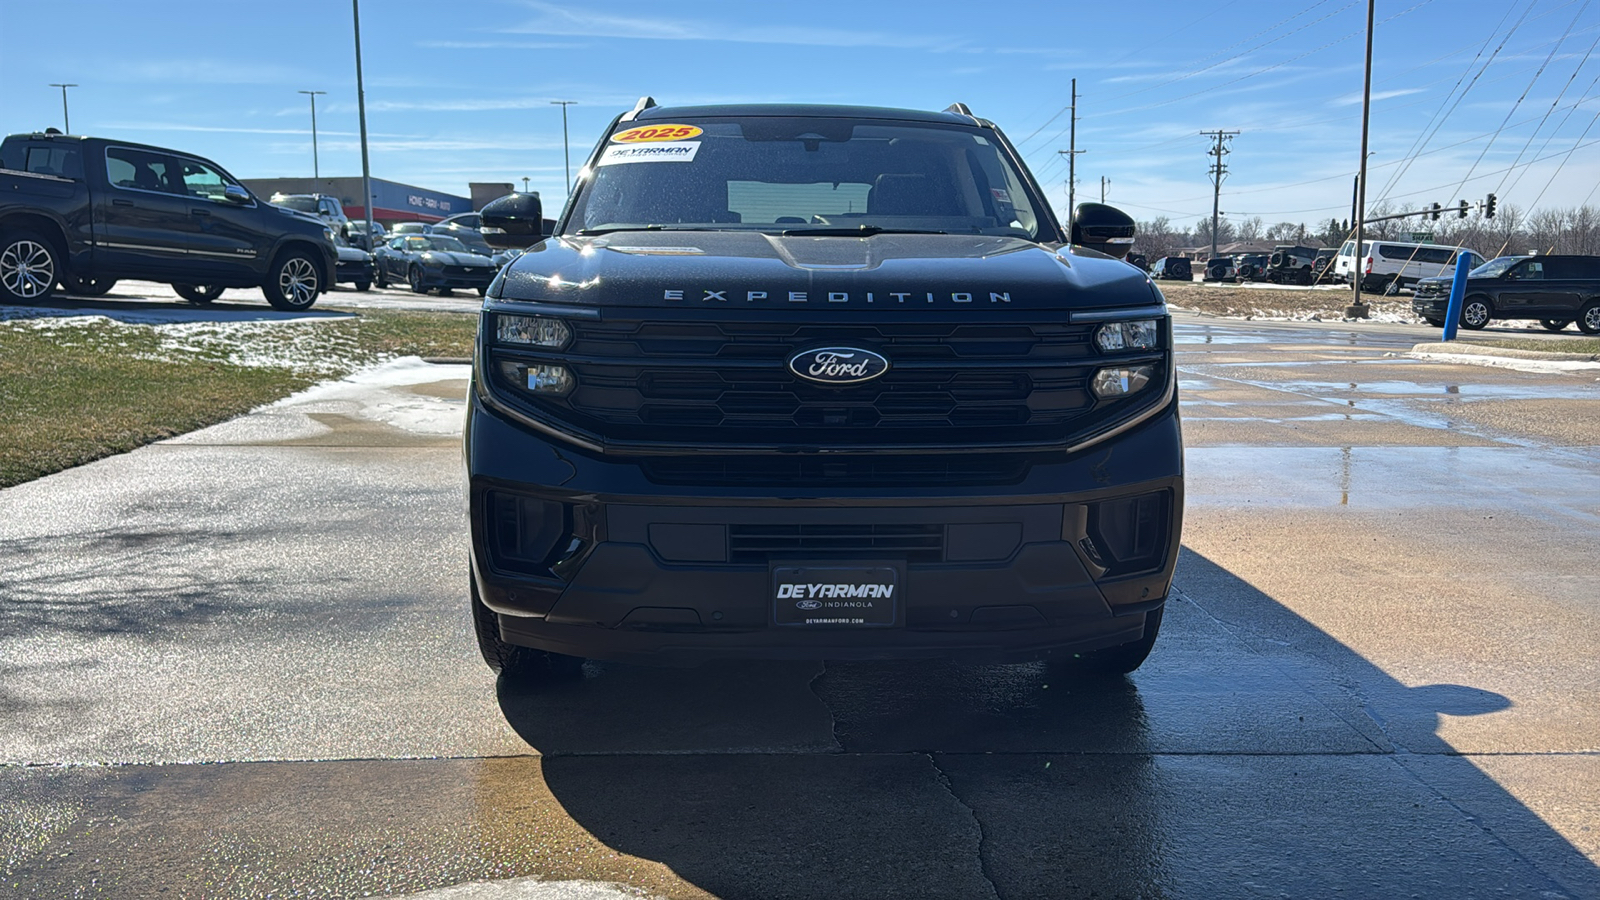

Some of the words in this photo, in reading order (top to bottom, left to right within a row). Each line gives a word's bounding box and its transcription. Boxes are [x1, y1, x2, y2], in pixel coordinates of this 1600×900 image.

[620, 127, 694, 141] 2025
[408, 194, 423, 207] HOME
[664, 289, 1011, 303] EXPEDITION
[808, 352, 869, 378] Ford
[776, 583, 894, 599] DEYARMAN
